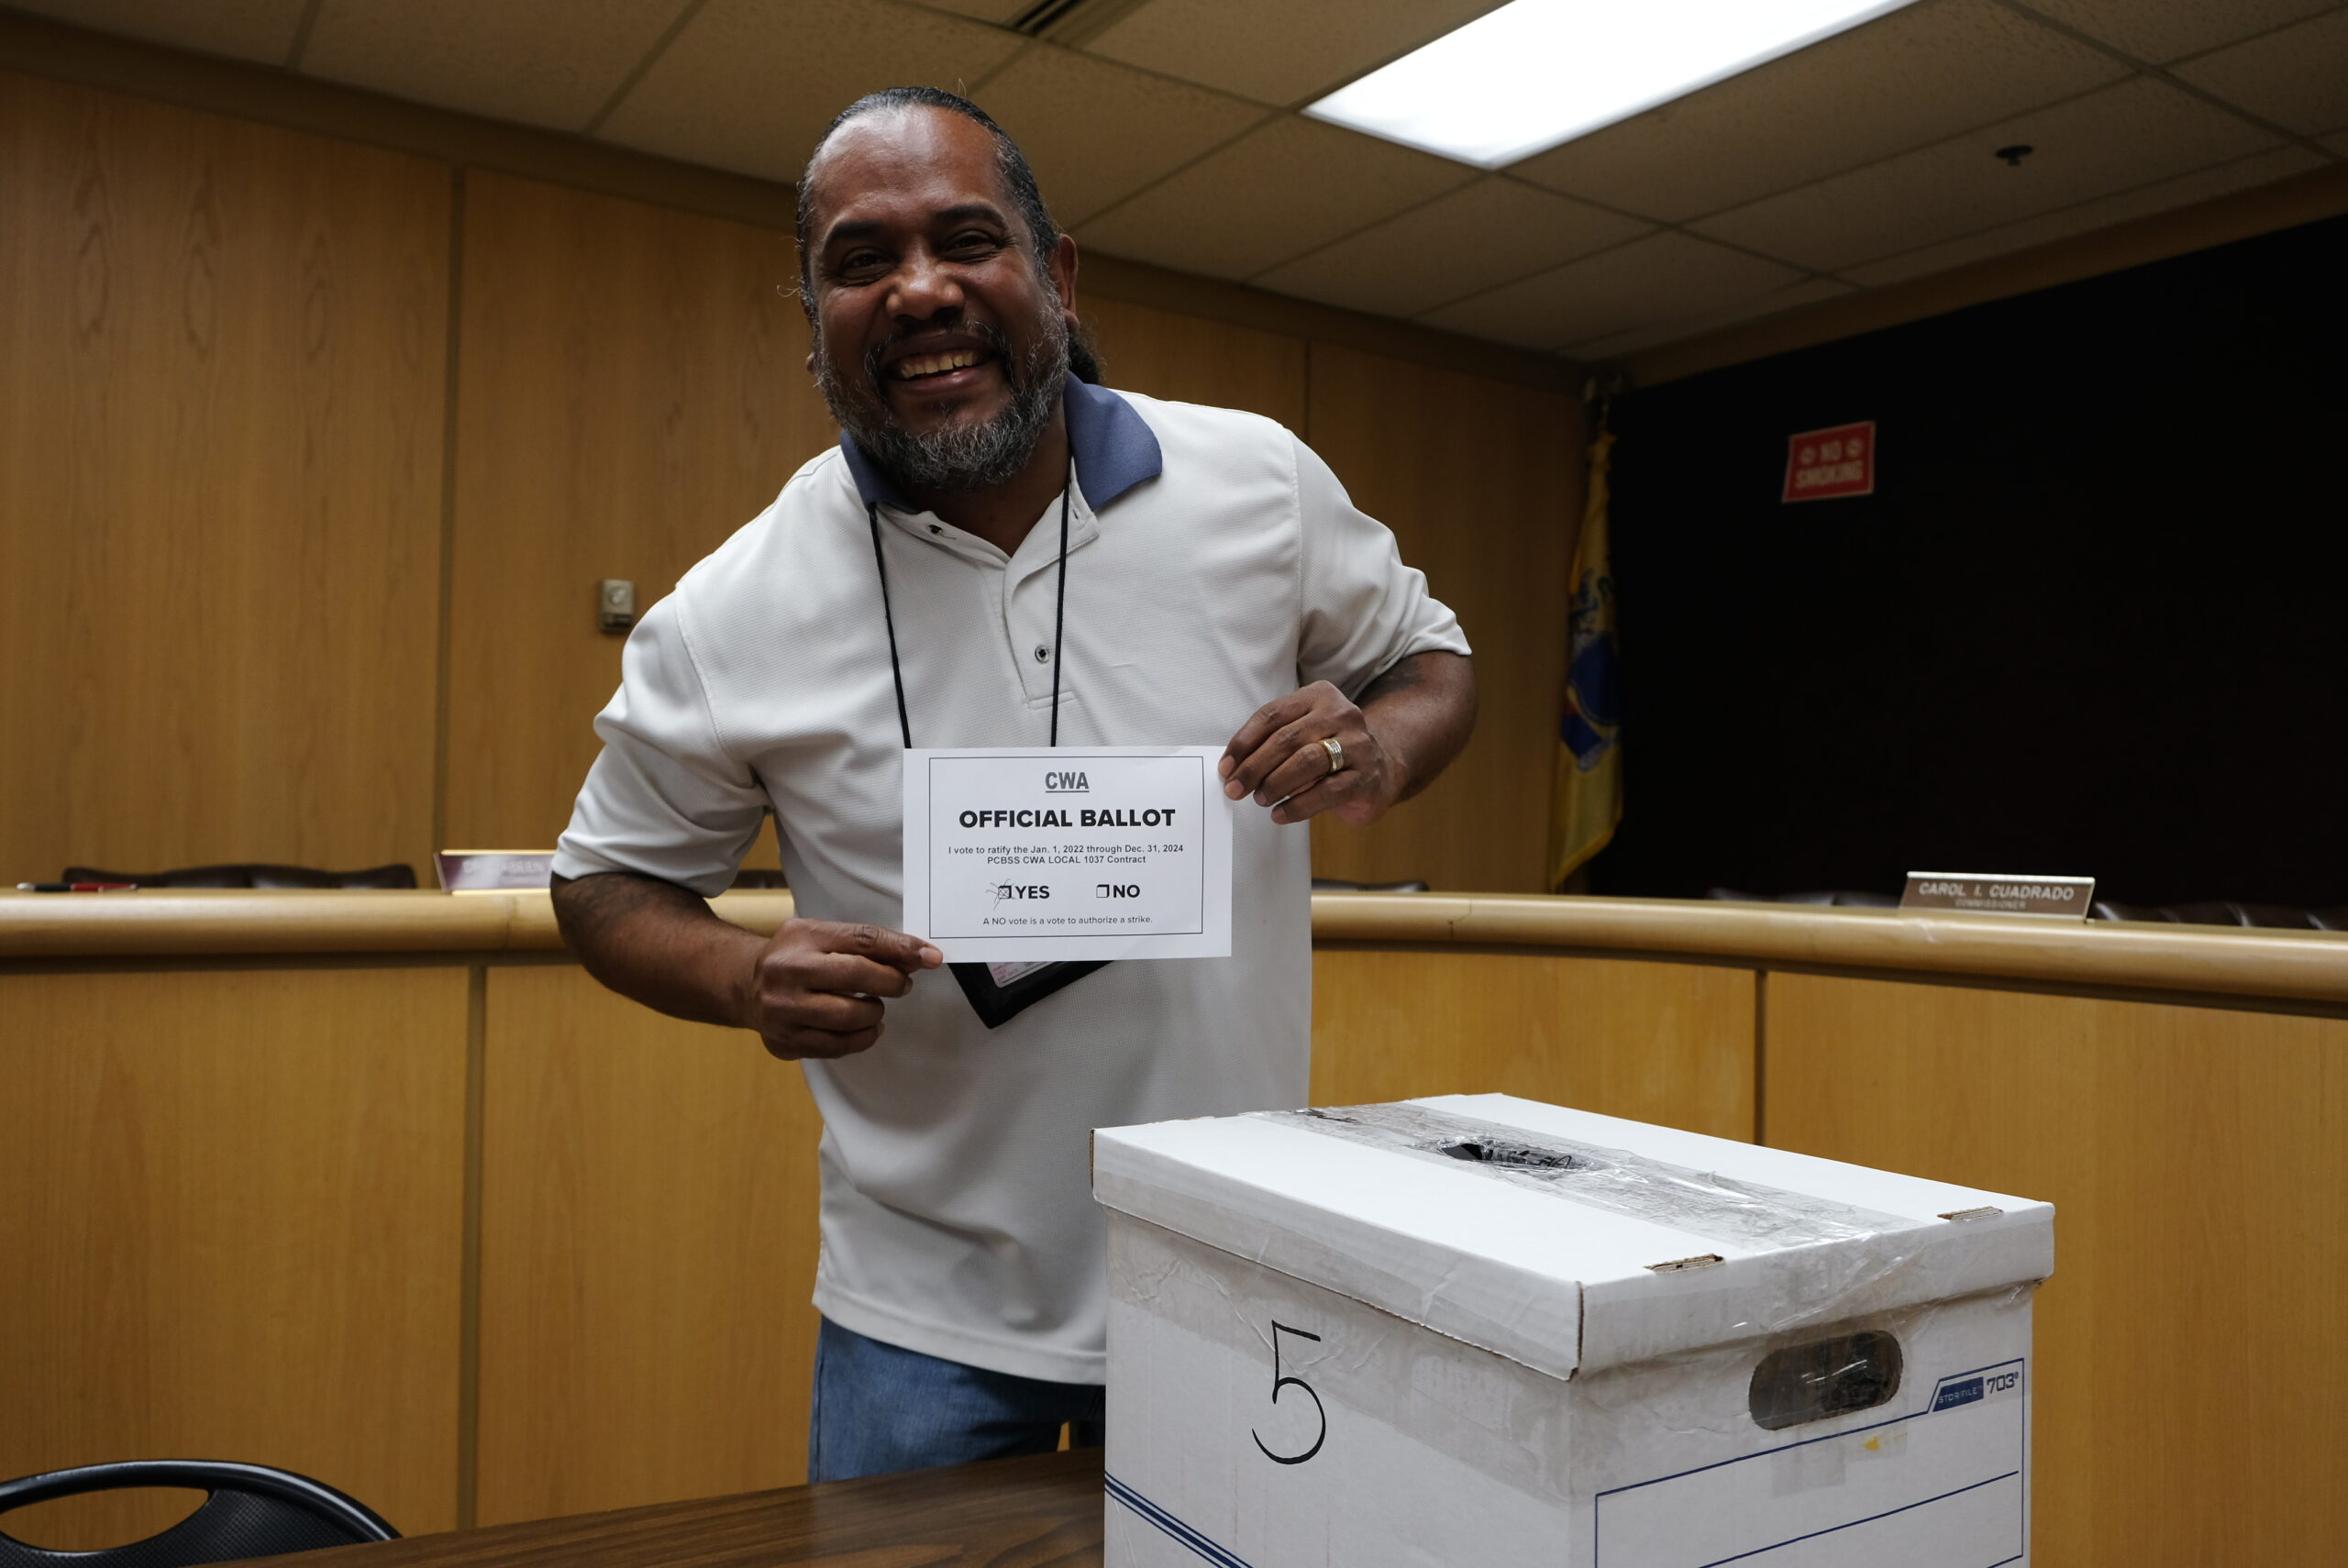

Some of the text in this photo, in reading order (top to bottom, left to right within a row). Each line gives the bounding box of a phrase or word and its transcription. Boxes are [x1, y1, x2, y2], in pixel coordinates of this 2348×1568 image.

[1045, 771, 1090, 790] CWA
[958, 808, 1176, 828] OFFICIAL BALLOT
[954, 846, 973, 855] vote
[976, 845, 985, 855] to
[988, 845, 1011, 856] ratify
[1013, 845, 1028, 854] the
[1030, 845, 1050, 854] Jan.
[1053, 845, 1060, 855] 1,
[1063, 845, 1084, 853] 2022
[1087, 844, 1123, 855] through
[1124, 844, 1145, 853] Dec.
[1147, 844, 1160, 854] 31,
[1163, 844, 1184, 853] 2024
[987, 855, 1146, 865] PCBSS CWA LOCAL 1037 Contract
[1015, 885, 1050, 900] YES
[1113, 884, 1140, 899] NO
[1919, 881, 1966, 897] CAROL
[1988, 884, 2075, 901] CUADRADO
[1955, 898, 2027, 911] COMMISSIONER
[983, 917, 990, 925] A
[991, 917, 1006, 925] NO
[1009, 917, 1028, 925] vote
[1079, 916, 1117, 924] authorize
[1127, 915, 1153, 923] strike.
[1252, 1319, 1326, 1465] 5
